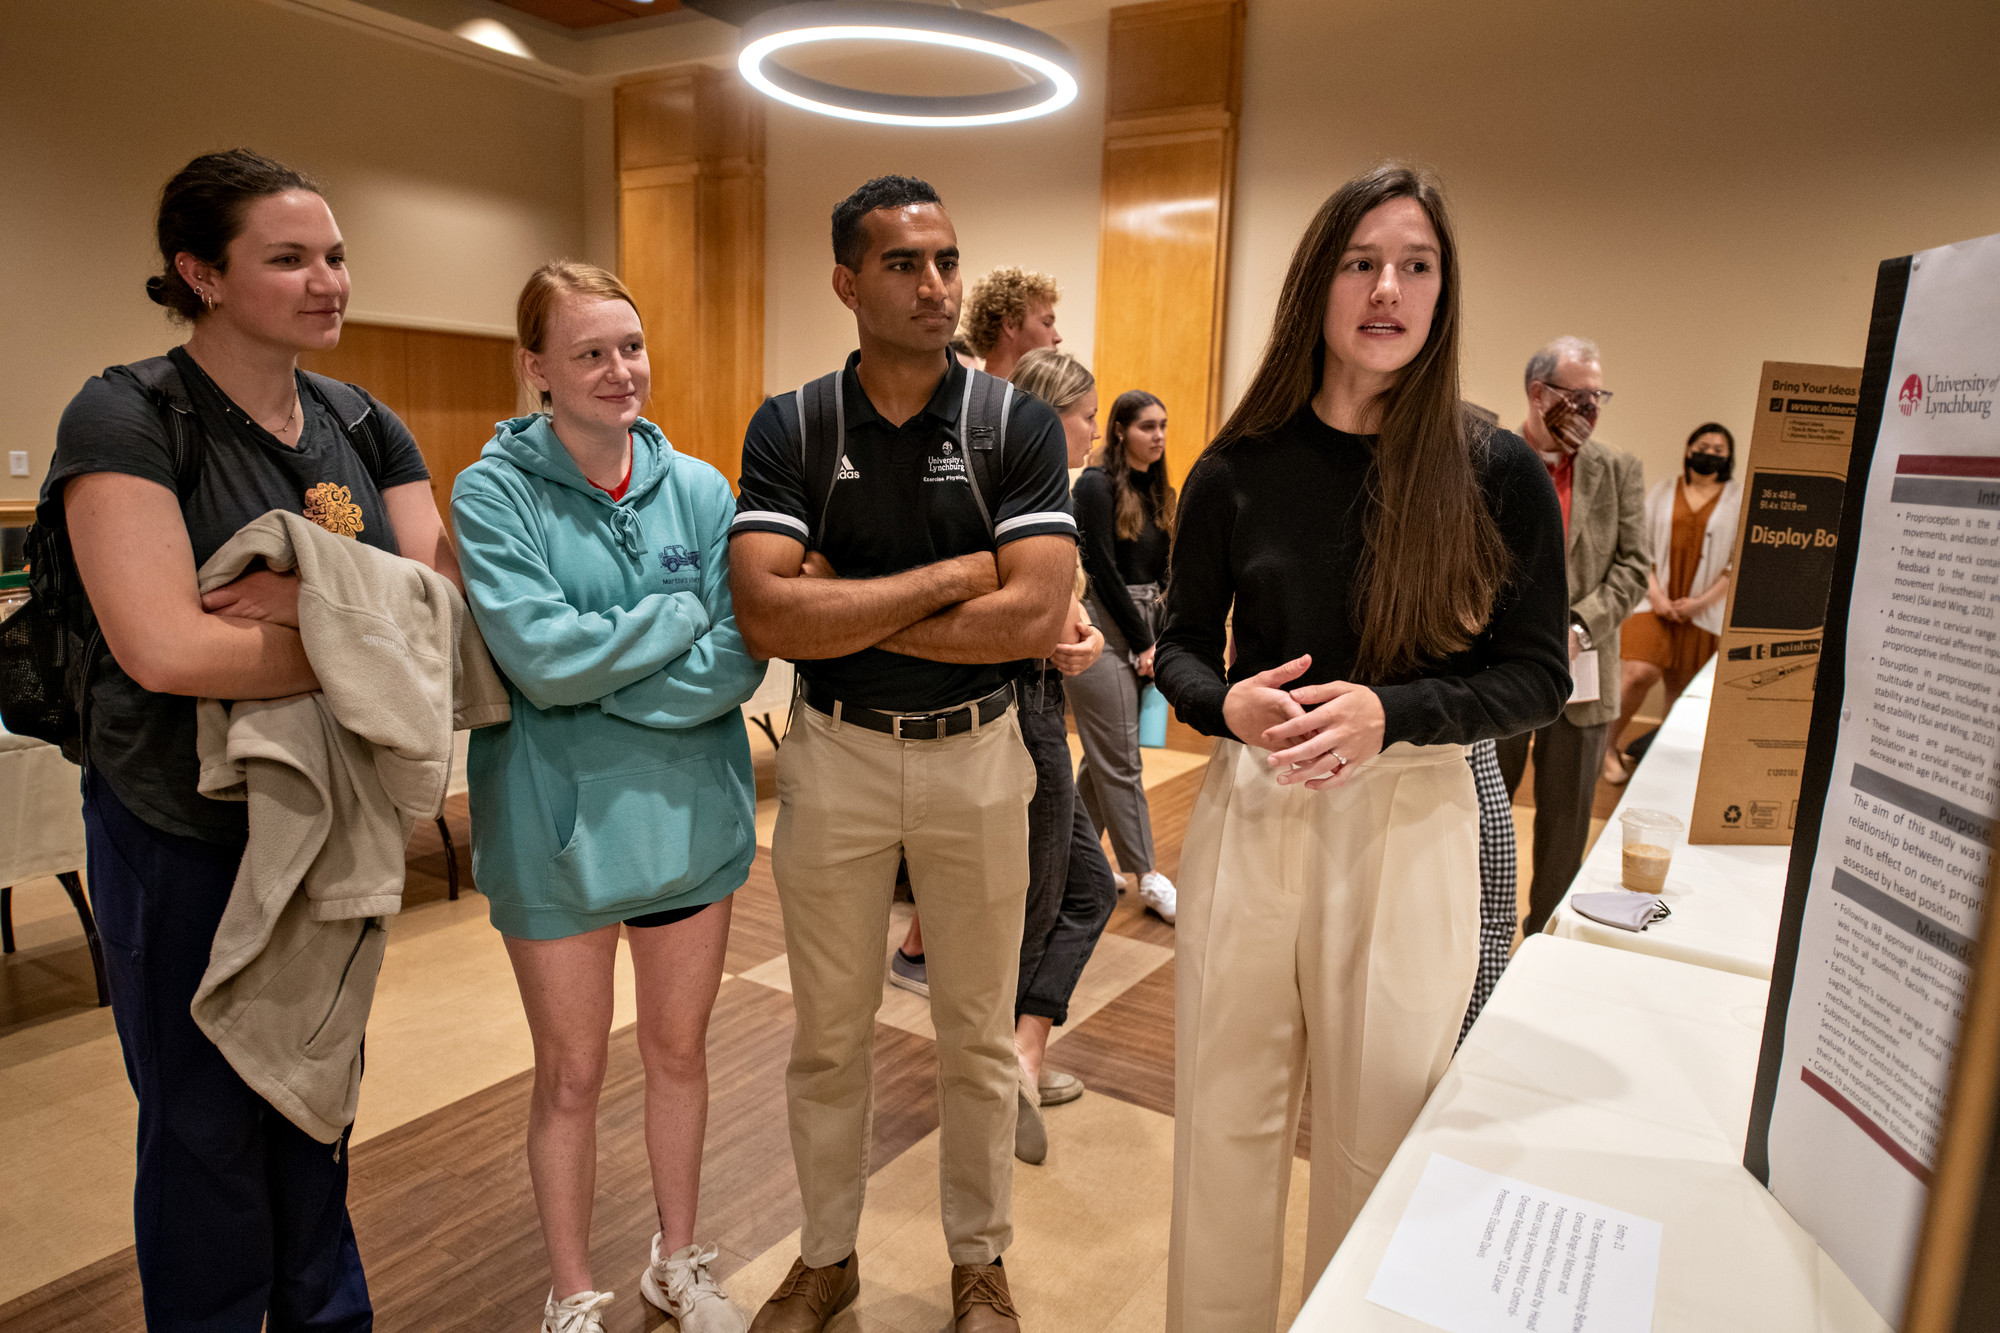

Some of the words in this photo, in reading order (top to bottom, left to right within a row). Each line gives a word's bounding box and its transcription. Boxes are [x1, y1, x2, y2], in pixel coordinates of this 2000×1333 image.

[1772, 380, 1800, 394] Bring
[1801, 382, 1827, 394] Your
[1828, 384, 1857, 396] Ideas
[1926, 373, 1989, 397] University
[1925, 394, 1992, 419] Lynchburg
[928, 456, 960, 465] University
[929, 463, 965, 473] Lynchburg
[1905, 512, 1960, 526] Proprioception
[1977, 520, 1990, 529] the
[1751, 525, 1812, 549] Display
[1814, 529, 1838, 547] Bo
[1903, 530, 1949, 543] movements,
[1950, 532, 1964, 543] and
[1965, 536, 1988, 546] action
[1901, 546, 1914, 556] The
[1917, 548, 1935, 559] head
[1938, 552, 1953, 561] and
[1956, 554, 1972, 564] neck
[1897, 561, 1930, 574] feedback
[1952, 569, 1965, 579] the
[1972, 574, 1998, 585] central
[1892, 592, 1916, 605] sense)
[1932, 599, 1946, 608] and
[1895, 578, 1934, 590] movement
[1938, 583, 1985, 600] (kinesthesia)
[1885, 624, 1922, 639] abnormal
[1922, 633, 1951, 646] cervical
[1952, 638, 1982, 652] afferent
[1888, 609, 1894, 618] A
[1897, 611, 1931, 625] decrease
[1943, 621, 1973, 634] cervical
[1975, 628, 1997, 641] range
[1882, 640, 1937, 658] proprioceptive
[1939, 650, 1982, 669] information
[1879, 656, 1918, 674] Disruption
[1924, 668, 1931, 677] in
[1937, 672, 1991, 694] proprioceptive
[1876, 673, 1913, 689] multitude
[1916, 682, 1926, 691] of
[1955, 692, 1989, 713] including
[1873, 701, 1885, 712] and
[1886, 705, 1917, 723] stability
[1934, 720, 1948, 731] and
[1874, 687, 1903, 704] stability
[1904, 695, 1920, 706] and
[1921, 697, 1940, 712] head
[1941, 704, 1971, 721] position
[1972, 714, 1995, 730] which
[1871, 734, 1906, 753] population
[1909, 749, 1918, 757] as
[1921, 752, 1949, 768] cervical
[1951, 764, 1972, 778] range
[1872, 717, 1890, 732] These
[1896, 727, 1919, 743] issues
[1926, 738, 1939, 748] are
[1944, 744, 1986, 767] particularly
[1869, 748, 1896, 765] decrease
[1898, 760, 1914, 772] with
[1916, 767, 1930, 778] age
[1853, 793, 1869, 810] The
[1872, 804, 1889, 819] aim
[1893, 813, 1905, 825] of
[1908, 818, 1926, 836] this
[1930, 830, 1956, 852] study
[1960, 845, 1981, 862] was
[1939, 806, 1991, 842] Purpose
[1845, 835, 1861, 850] and
[1863, 843, 1874, 857] its
[1876, 851, 1902, 872] effect
[1904, 866, 1918, 880] on
[1920, 874, 1946, 895] one's
[1848, 815, 1899, 848] relationship
[1902, 838, 1944, 869] between
[1946, 862, 1989, 890] cervical
[1843, 855, 1879, 882] assessed
[1881, 873, 1892, 890] by
[1893, 881, 1917, 902] head
[1918, 896, 1964, 928] position.
[1840, 904, 1869, 930] Following
[1871, 922, 1882, 936] IRB
[1884, 932, 1914, 955] approval
[1915, 919, 1974, 963] Methods
[1838, 919, 1850, 932] was
[1851, 928, 1880, 951] recruited
[1881, 946, 1909, 969] through
[1835, 934, 1849, 948] sent
[1933, 997, 1949, 1011] and
[1825, 992, 1861, 1020] mechanical
[1830, 961, 1846, 977] Each
[1848, 974, 1874, 997] subject's
[1876, 993, 1902, 1015] cervical
[1903, 1011, 1924, 1032] range
[1821, 1018, 1846, 1043] Sensory
[1848, 1036, 1868, 1057] Motor
[1823, 1003, 1850, 1029] Subjects
[1851, 1025, 1886, 1055] performed
[1898, 1026, 1913, 1040] and
[1918, 1037, 1943, 1062] frontal
[1816, 1046, 1832, 1063] their
[1833, 1059, 1849, 1076] head
[1850, 1073, 1891, 1112] repositioning
[1818, 1034, 1846, 1058] evaluate
[1848, 1054, 1864, 1071] their
[1865, 1069, 1912, 1111] proprioceptive
[1814, 1061, 1843, 1087] Covid-19
[1842, 1084, 1872, 1112] protocols
[1873, 1109, 1889, 1126] were
[1889, 1120, 1918, 1151] followed
[1514, 1195, 1531, 1221] Oriented
[1535, 1200, 1550, 1223] Position
[1483, 1217, 1500, 1241] Elizabeth
[1527, 1222, 1543, 1238] Using
[1548, 1206, 1568, 1246] Proprioceptive
[1572, 1212, 1587, 1234] Cervical
[1476, 1240, 1492, 1259] Davis
[1519, 1242, 1538, 1265] Sensory
[1566, 1232, 1582, 1252] Range
[1567, 1250, 1577, 1260] of
[1584, 1232, 1603, 1261] Examining
[1613, 1241, 1625, 1251] 21
[1497, 1260, 1510, 1275] LED
[1516, 1264, 1531, 1287] Motor
[1560, 1258, 1576, 1281] Motion
[1585, 1260, 1596, 1272] the
[1491, 1273, 1506, 1295] Laser
[1534, 1268, 1551, 1300] Assessed
[1558, 1280, 1569, 1296] and
[1574, 1271, 1595, 1313] Relationship
[1507, 1286, 1525, 1317] Control-
[1530, 1299, 1544, 1310] by
[1526, 1309, 1541, 1333] Head
